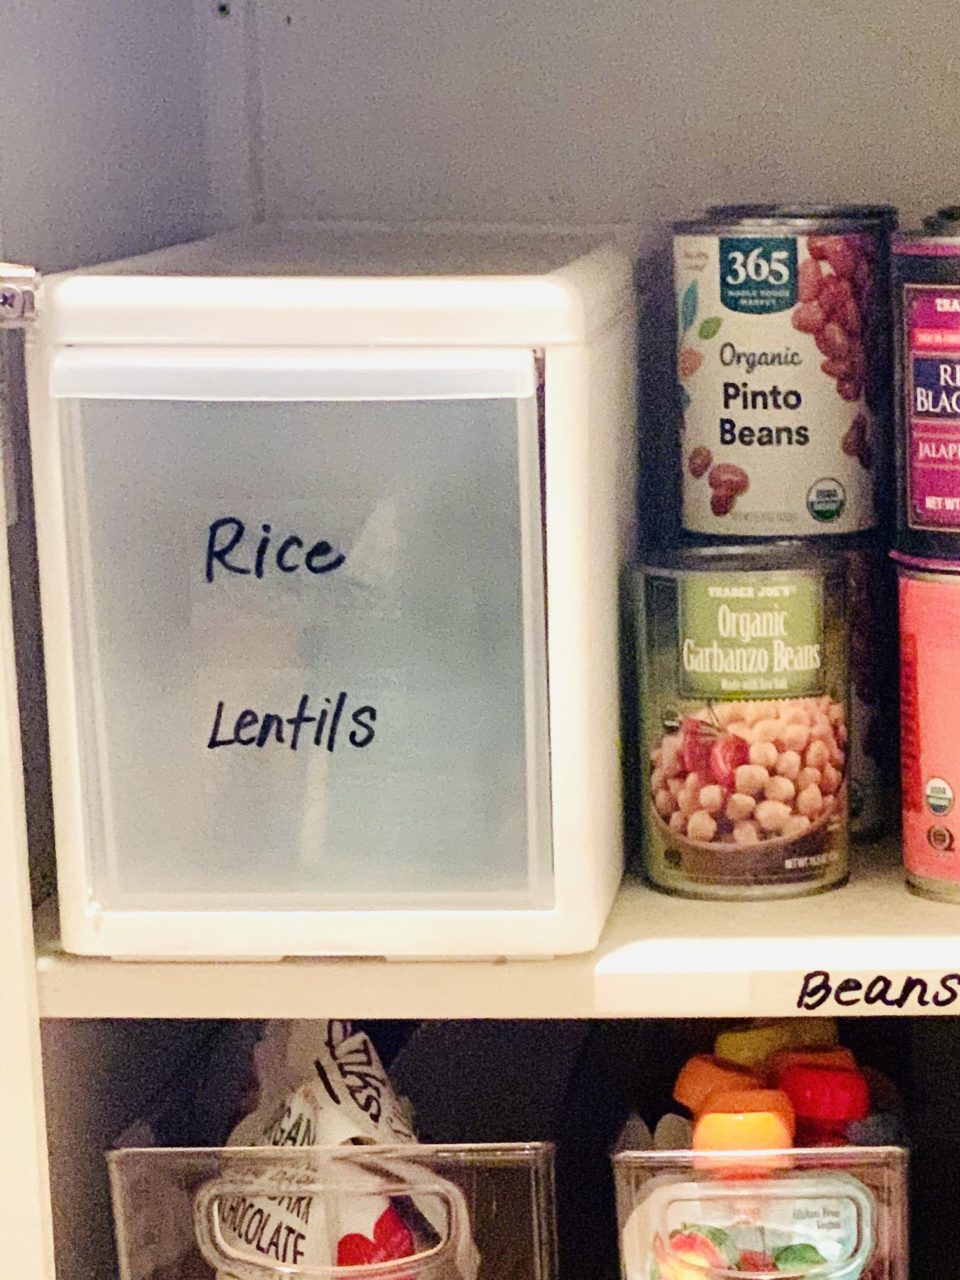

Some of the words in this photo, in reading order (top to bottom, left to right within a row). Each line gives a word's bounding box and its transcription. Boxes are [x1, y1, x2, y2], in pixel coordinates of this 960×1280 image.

[726, 247, 790, 285] 365
[719, 341, 802, 373] Organic
[723, 382, 802, 410] Pinto
[719, 418, 810, 446] Beans
[206, 517, 346, 584] Rice
[718, 604, 788, 643] Organic
[683, 638, 769, 673] Garbanzo
[773, 639, 821, 673] Beans
[207, 691, 377, 752] Lentils
